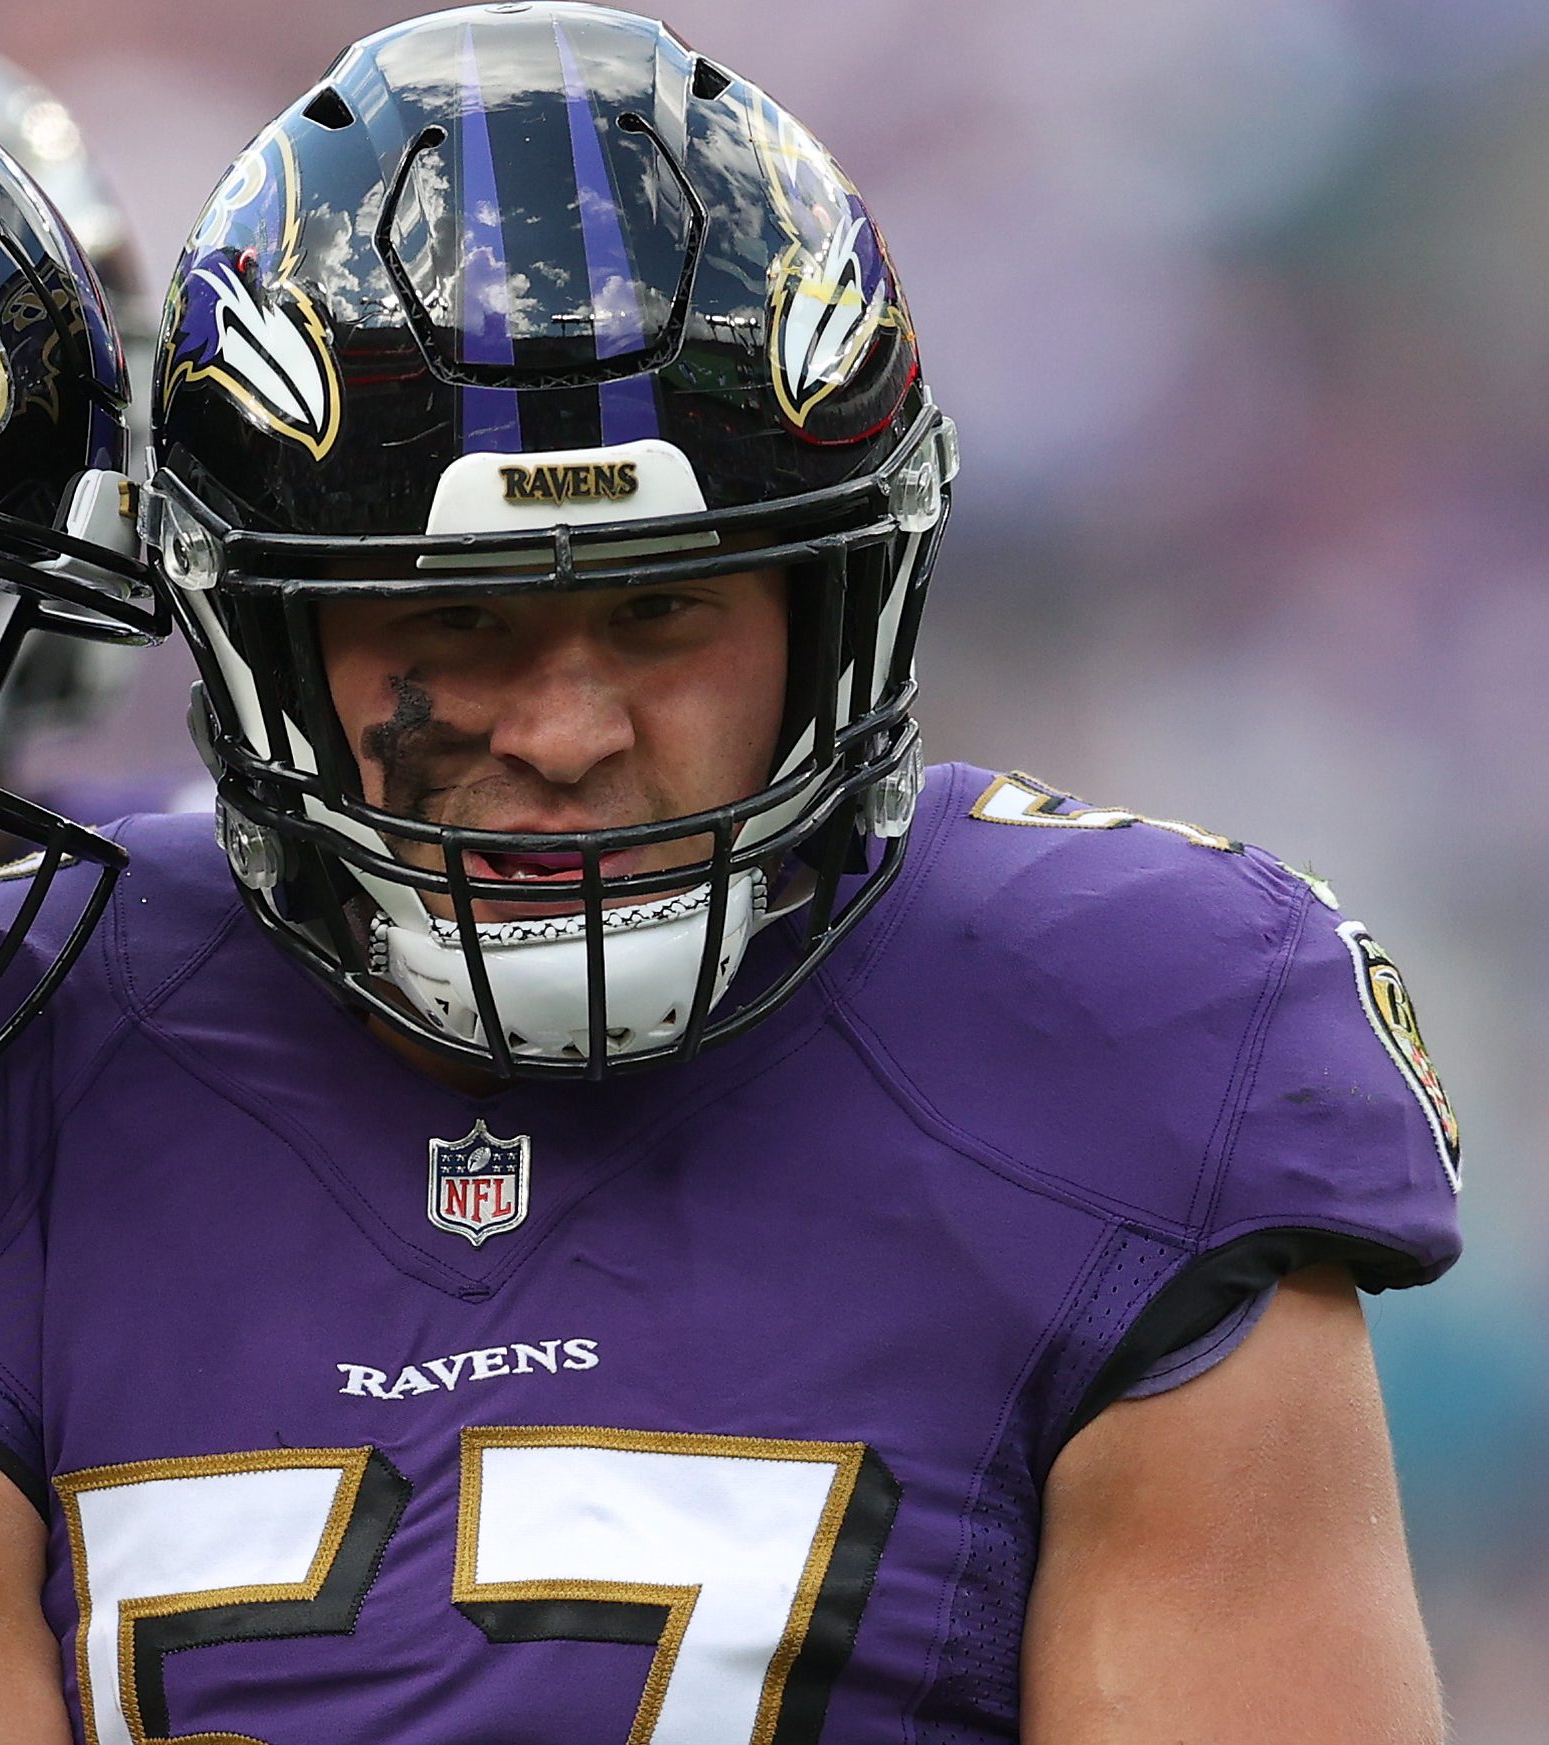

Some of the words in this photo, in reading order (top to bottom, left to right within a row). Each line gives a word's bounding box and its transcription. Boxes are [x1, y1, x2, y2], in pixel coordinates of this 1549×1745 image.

[498, 460, 640, 507] RAVENS
[445, 1178, 512, 1223] NFL
[337, 1338, 600, 1400] RAVENS
